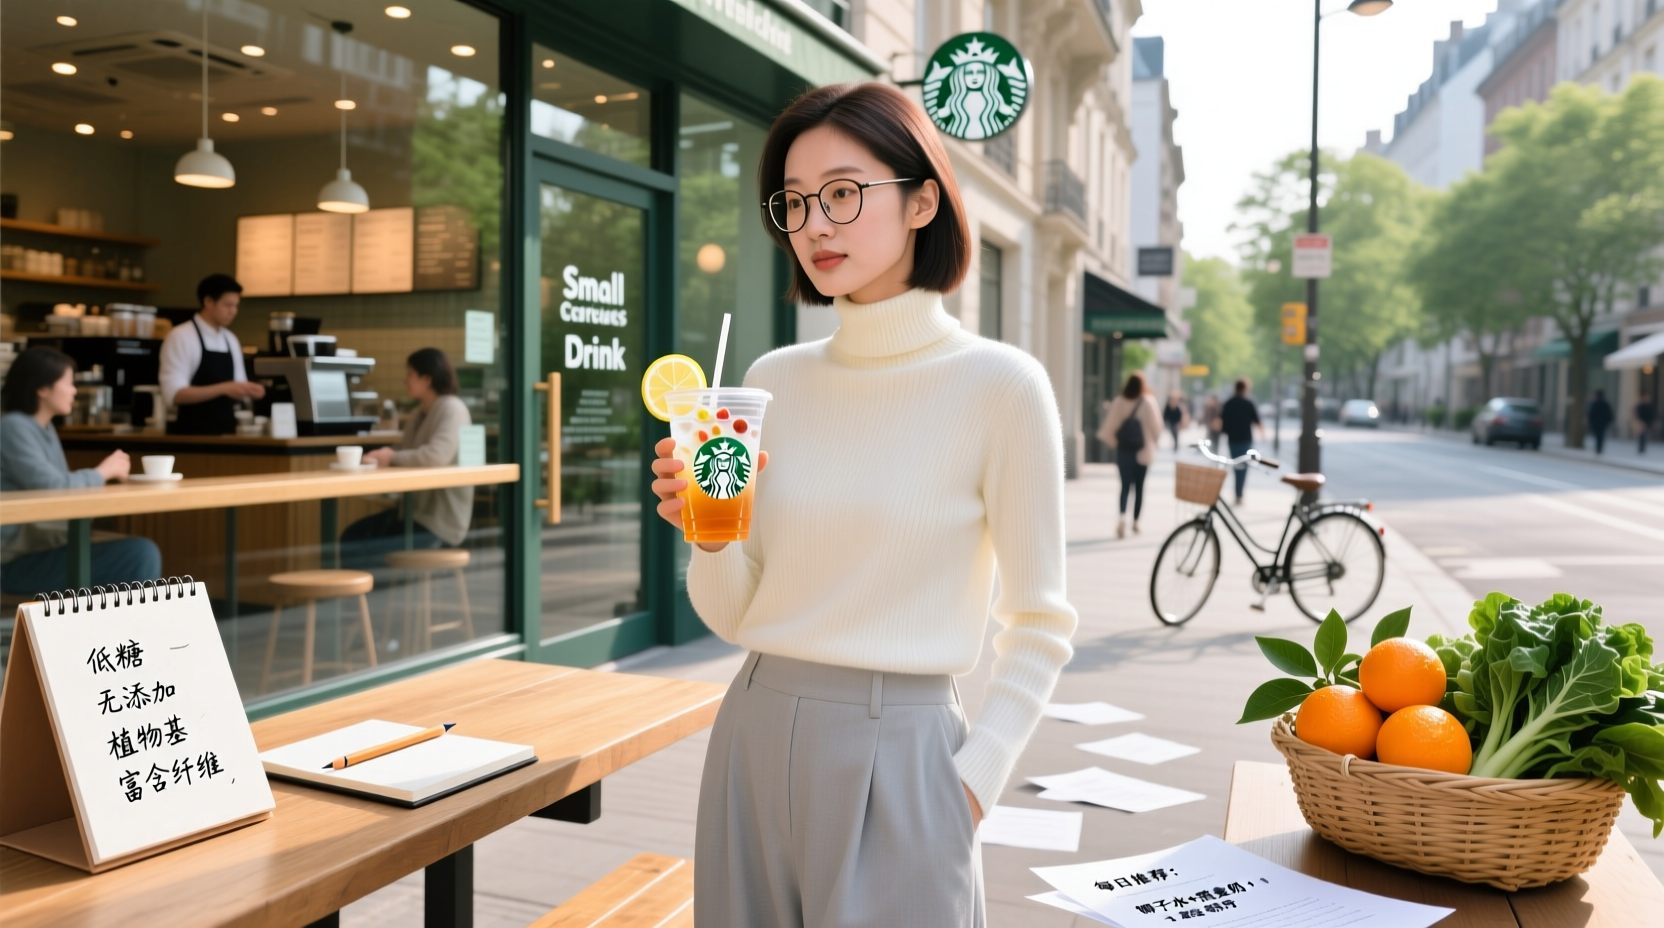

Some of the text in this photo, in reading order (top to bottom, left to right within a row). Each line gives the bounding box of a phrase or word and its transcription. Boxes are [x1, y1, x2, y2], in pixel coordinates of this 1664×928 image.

[563, 265, 625, 306] Small
[565, 334, 627, 371] Drink
[87, 639, 144, 675] 低糖
[97, 681, 176, 715] 无添加
[107, 714, 189, 761] 植物基
